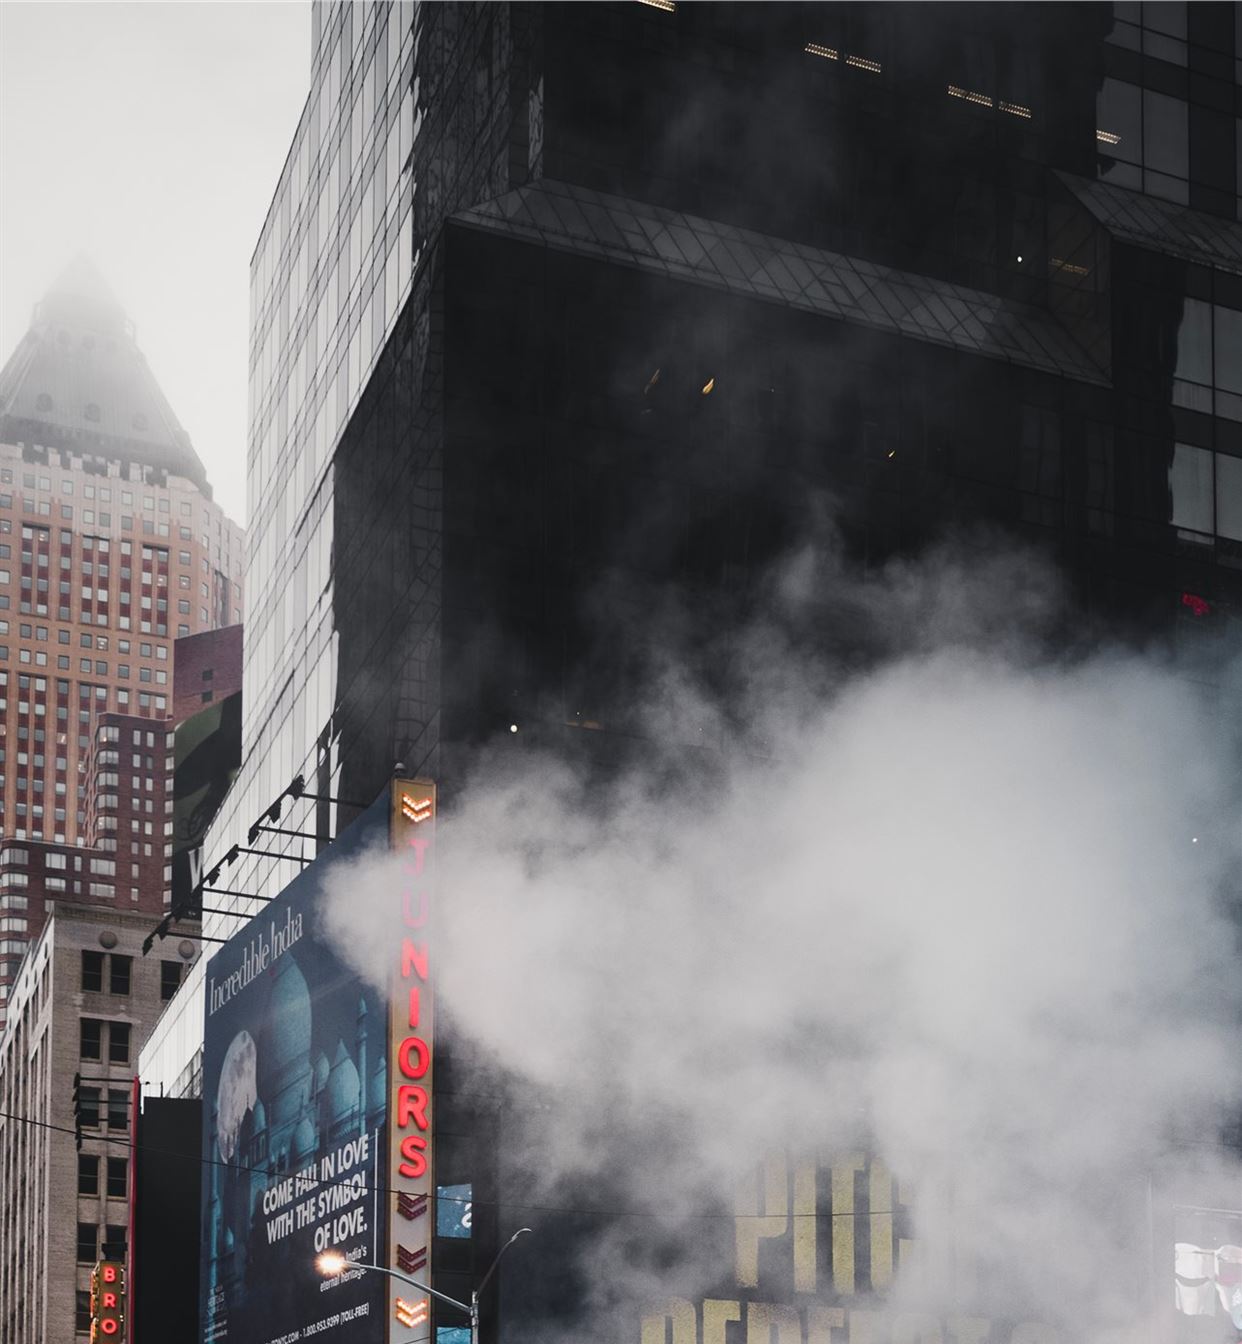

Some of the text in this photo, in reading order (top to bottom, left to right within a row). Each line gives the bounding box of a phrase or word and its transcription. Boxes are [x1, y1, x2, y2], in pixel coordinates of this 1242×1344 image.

[209, 906, 303, 1016] Incredible India
[399, 837, 430, 1179] JUNIORS
[263, 1133, 369, 1215] COME FALL IN LOVE
[266, 1170, 368, 1245] WITH THE SYMBOL
[314, 1206, 368, 1253] OF LOVE.
[346, 1244, 367, 1262] India's
[733, 1148, 925, 1294] PITC
